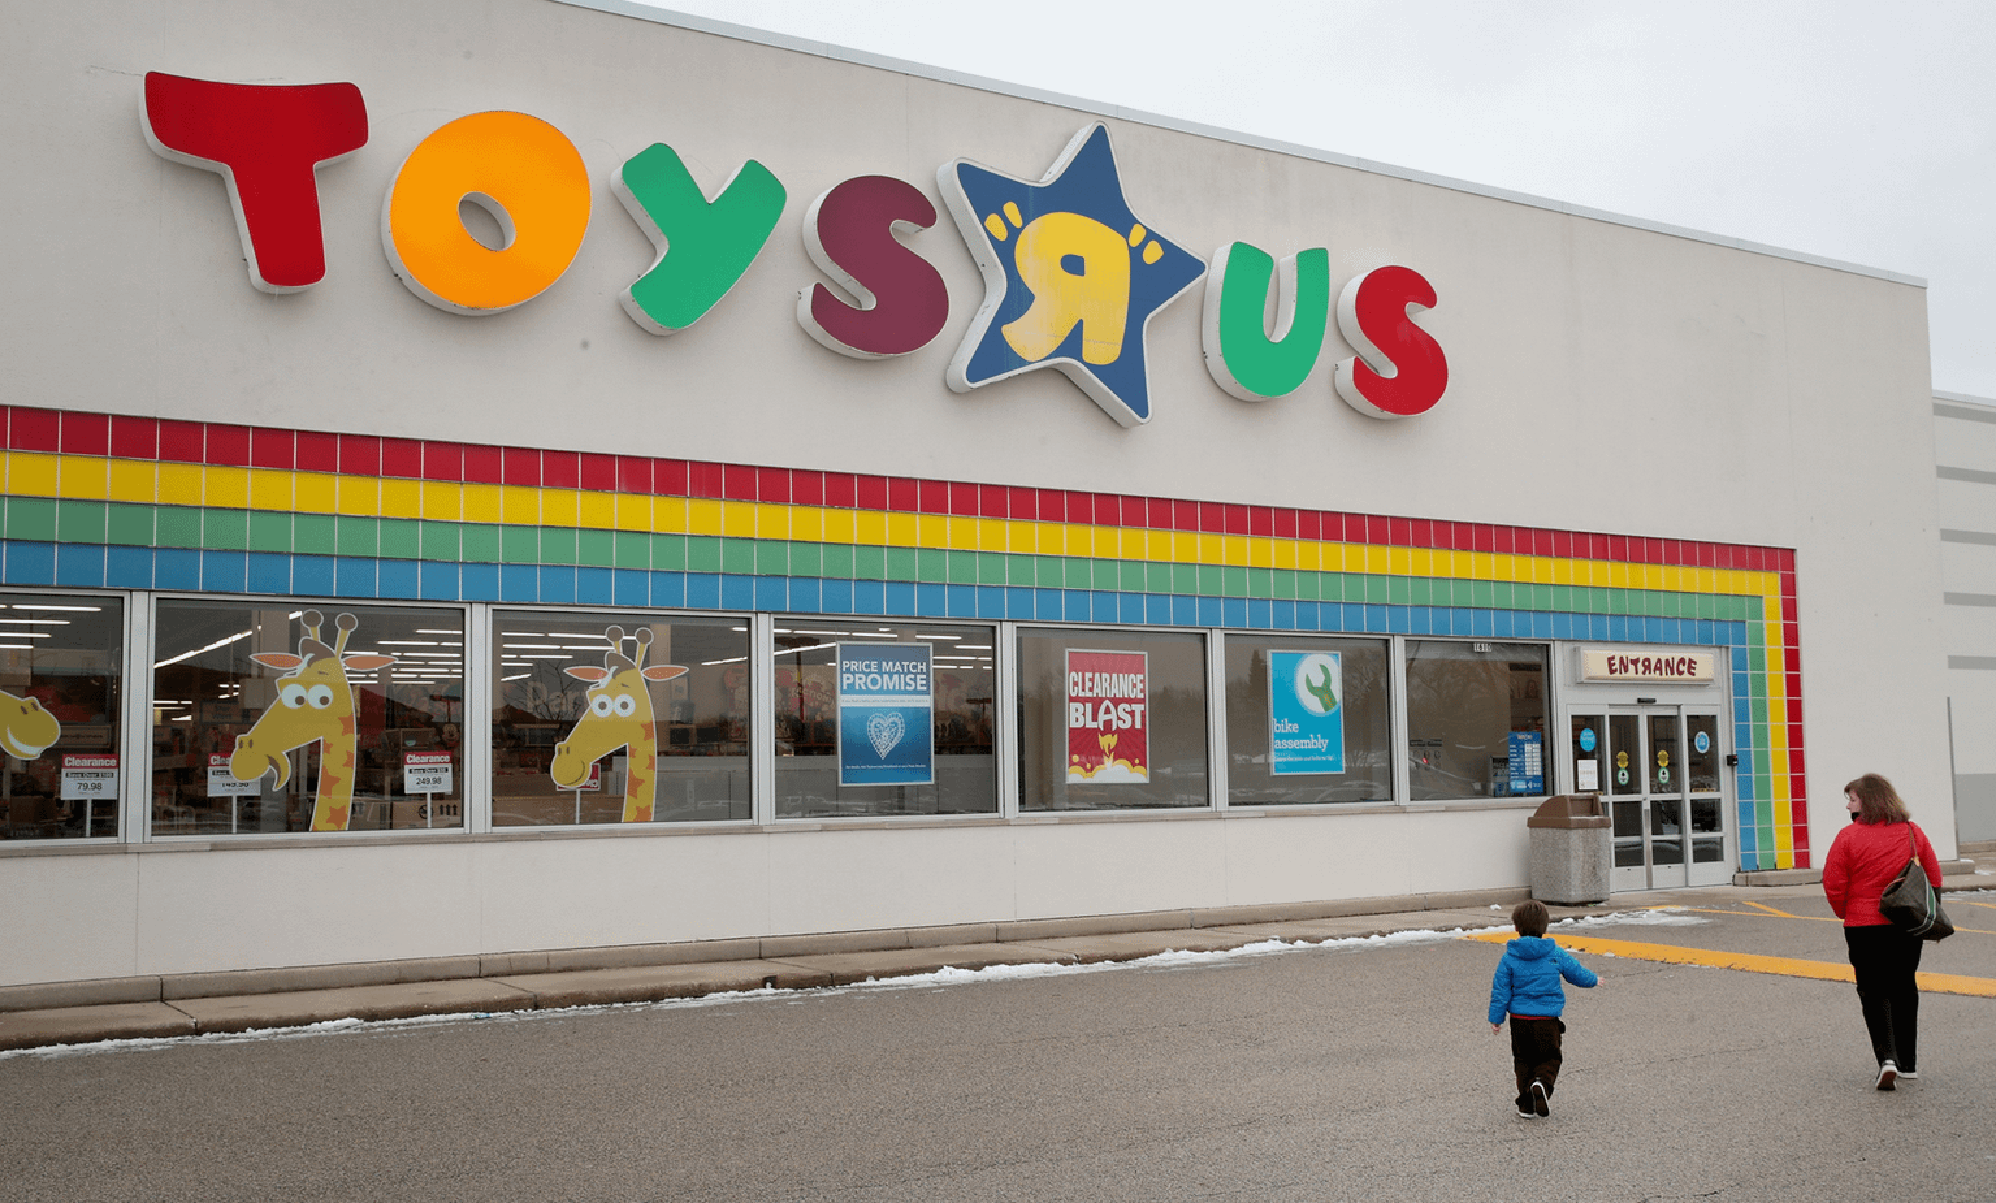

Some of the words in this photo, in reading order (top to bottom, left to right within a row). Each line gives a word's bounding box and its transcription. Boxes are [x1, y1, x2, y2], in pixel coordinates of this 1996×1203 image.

[140, 71, 950, 358] TOYS
[1203, 241, 1449, 419] US
[842, 661, 879, 672] PRICE
[882, 661, 927, 673] MATCH
[1606, 655, 1698, 677] ENTRANCE
[842, 673, 927, 690] PROMISE
[1069, 671, 1144, 699] CLEARANCE
[1068, 699, 1145, 731] BLAST
[1274, 718, 1299, 733] bike
[1274, 734, 1329, 752] assembly
[64, 756, 118, 767] Clearance
[406, 753, 451, 763] Clearance
